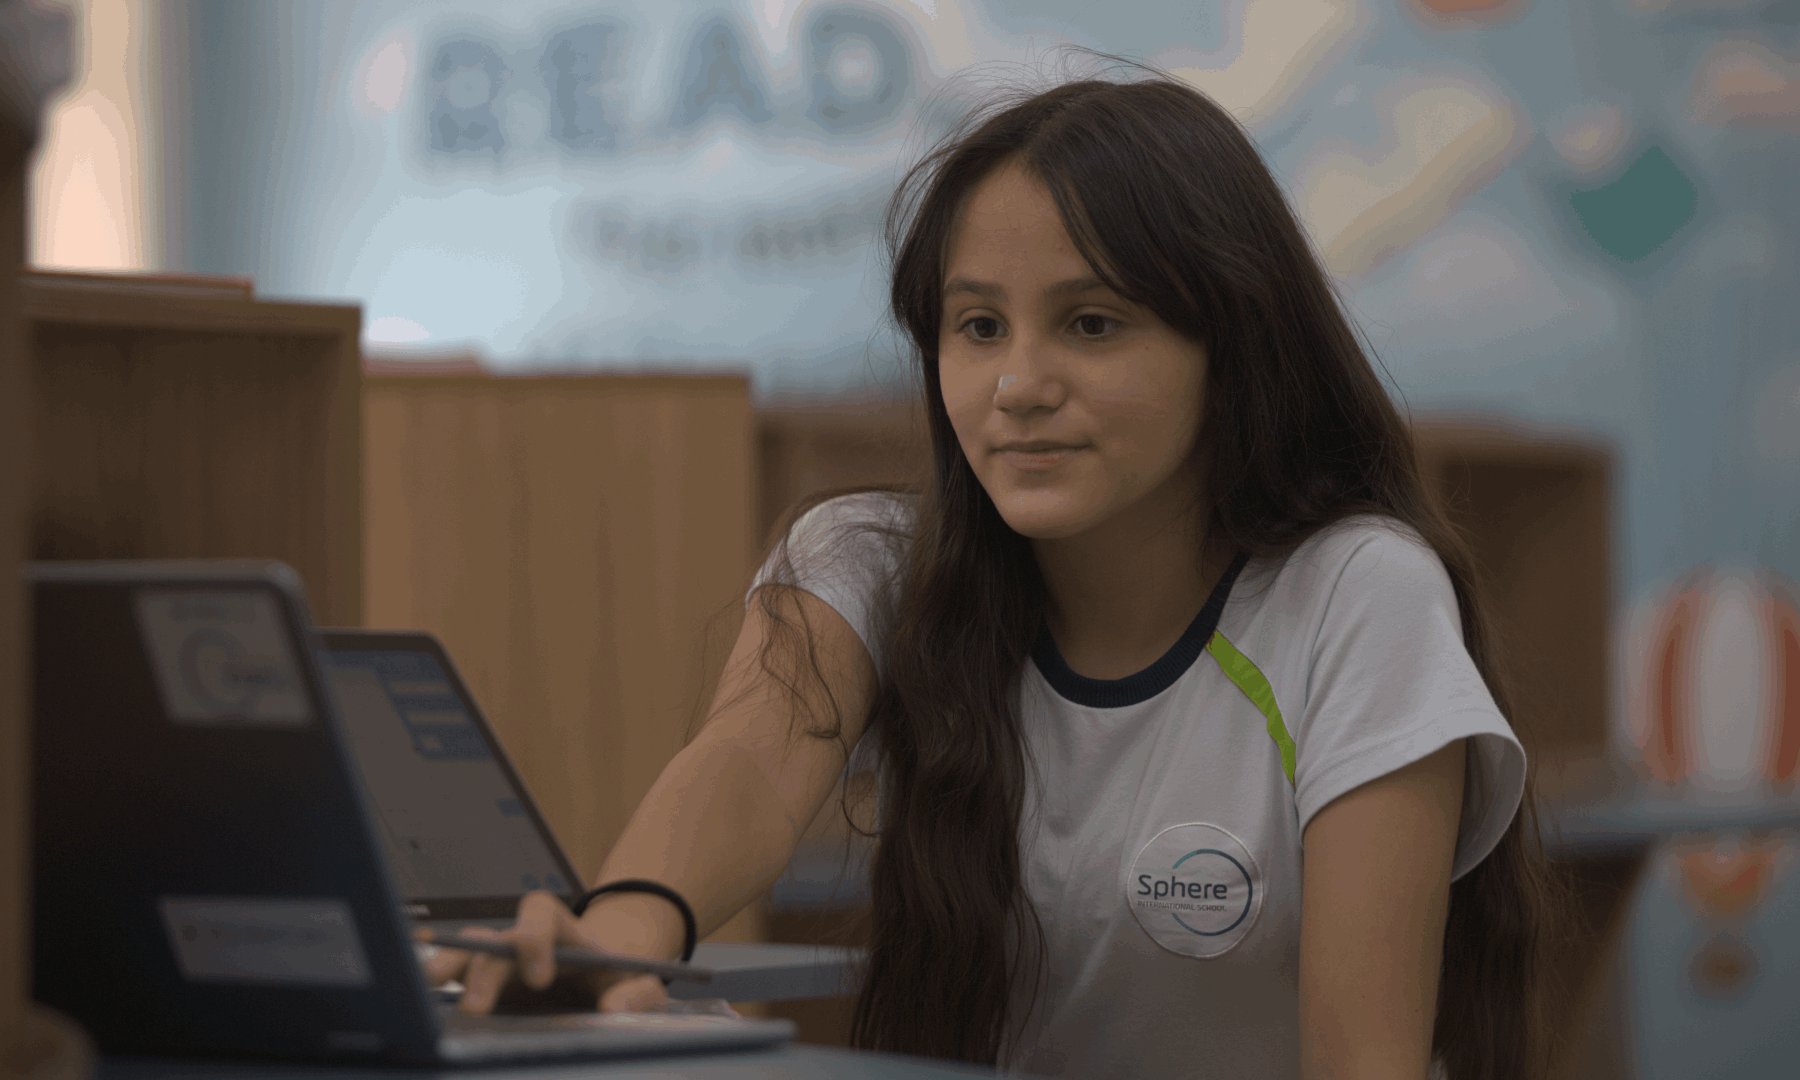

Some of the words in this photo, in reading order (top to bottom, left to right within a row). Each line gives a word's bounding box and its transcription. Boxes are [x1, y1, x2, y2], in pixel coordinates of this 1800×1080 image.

[424, 4, 914, 158] READ
[1137, 874, 1228, 900] Sphere
[1137, 900, 1195, 911] INTERNATIONAL
[1197, 904, 1227, 912] SCHOOL
